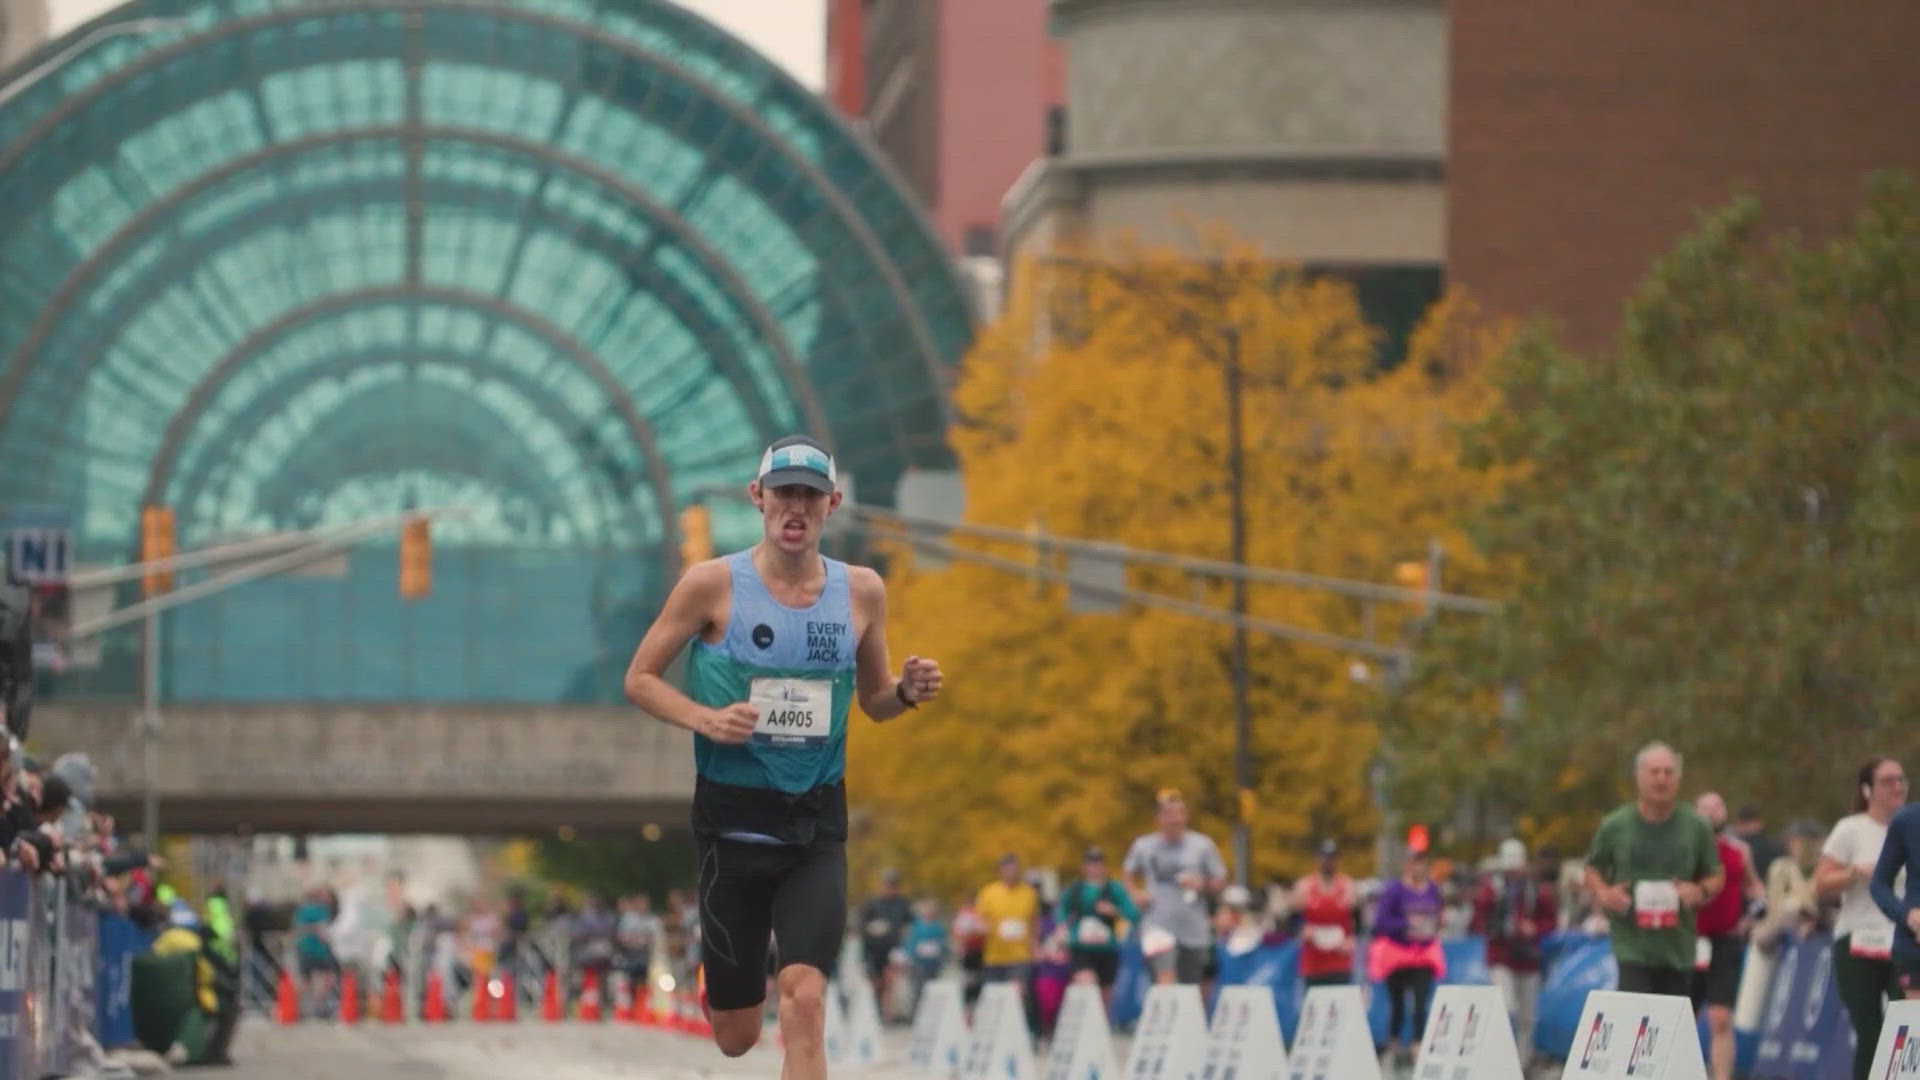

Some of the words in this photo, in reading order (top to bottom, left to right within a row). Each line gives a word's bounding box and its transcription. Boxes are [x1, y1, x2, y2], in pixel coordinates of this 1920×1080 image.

[807, 621, 847, 637] EVERY
[807, 635, 837, 649] MAN
[766, 709, 814, 729] A4905
